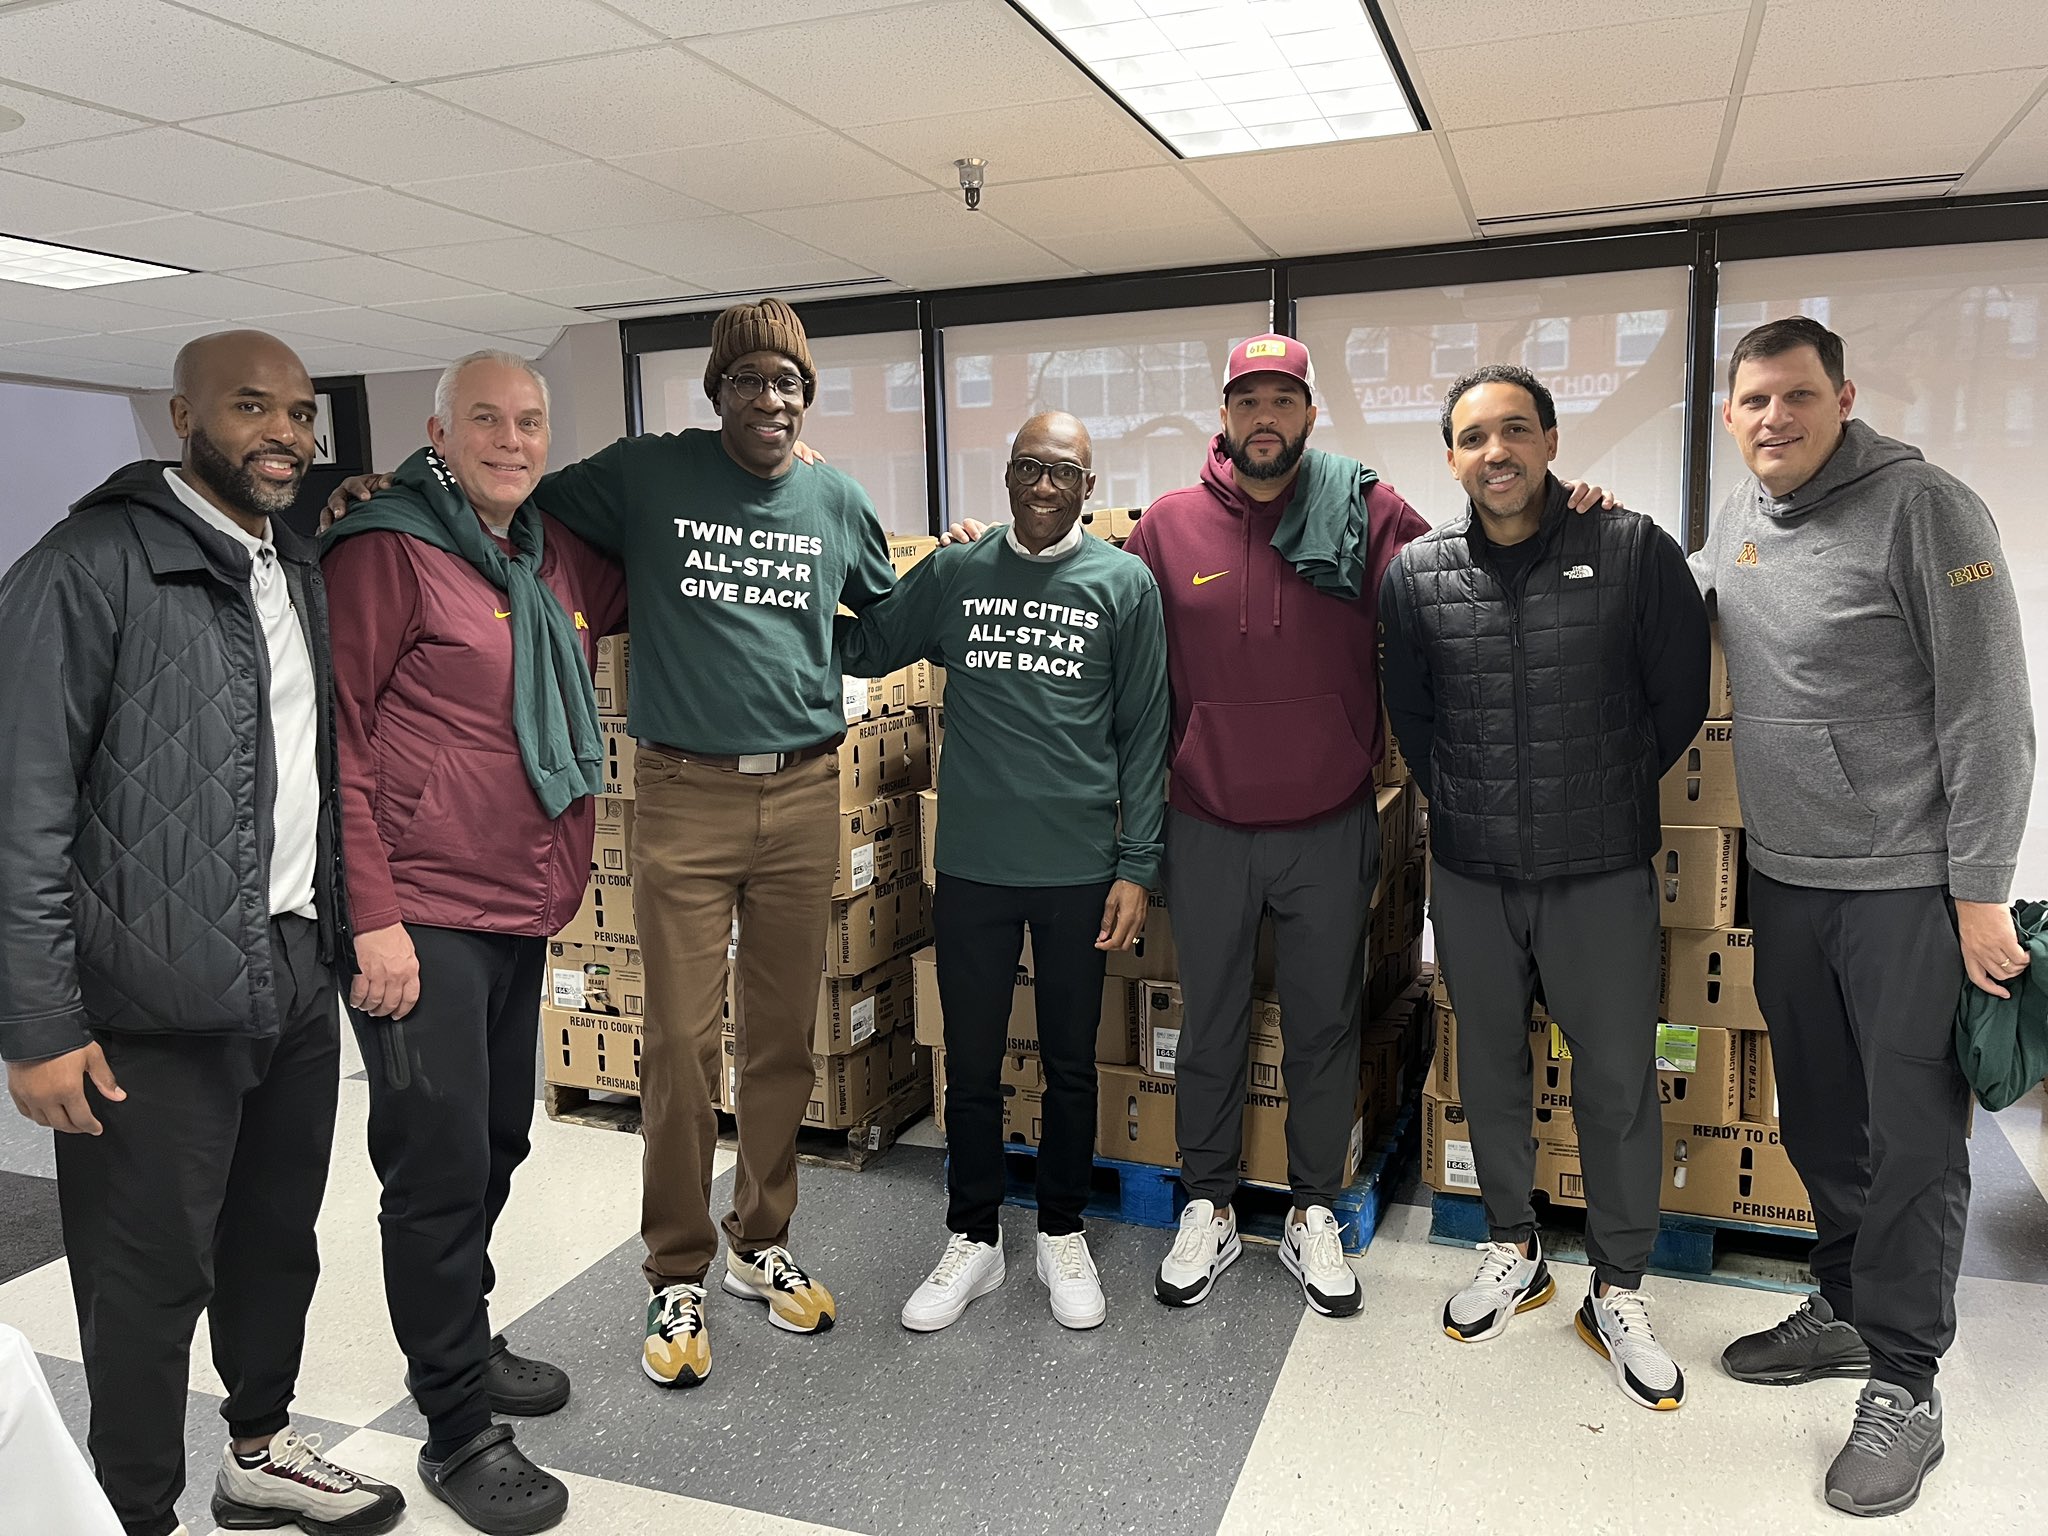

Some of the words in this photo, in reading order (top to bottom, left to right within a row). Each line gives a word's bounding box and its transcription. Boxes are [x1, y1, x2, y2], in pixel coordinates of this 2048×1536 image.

[1249, 343, 1267, 354] 612
[673, 518, 743, 546] TWIN
[749, 529, 823, 556] CITIES
[892, 545, 917, 558] TURKEY
[680, 577, 739, 603] GIVE
[744, 585, 811, 610] BACK
[962, 598, 1018, 617] TWIN
[1023, 600, 1100, 630] CITIES
[965, 650, 1013, 670] GIVE
[1017, 652, 1084, 680] BACK
[859, 724, 879, 740] READY
[880, 723, 888, 734] TO
[888, 718, 904, 732] COOK
[1721, 834, 1731, 872] PRODUCT
[594, 874, 606, 885] TO
[608, 875, 632, 887] COOK
[1721, 874, 1729, 886] OF
[1719, 887, 1728, 912] U.S.A.
[841, 922, 849, 931] OF
[841, 933, 850, 964] PRODUCT
[831, 980, 840, 1011] PRODUCT
[570, 1015, 596, 1029] READY
[598, 1020, 608, 1030] TO
[611, 1021, 634, 1034] COOK
[832, 1012, 840, 1021] OF
[1443, 1034, 1449, 1046] OF
[838, 1075, 846, 1083] OF
[1729, 1073, 1735, 1084] OF
[1749, 1065, 1756, 1076] OF
[1139, 1080, 1176, 1095] READY
[838, 1085, 847, 1115] PRODUCT
[1426, 1102, 1434, 1138] PRODUCT
[1693, 1124, 1741, 1140] READY
[1744, 1128, 1764, 1143] TO
[1426, 1138, 1434, 1150] OF
